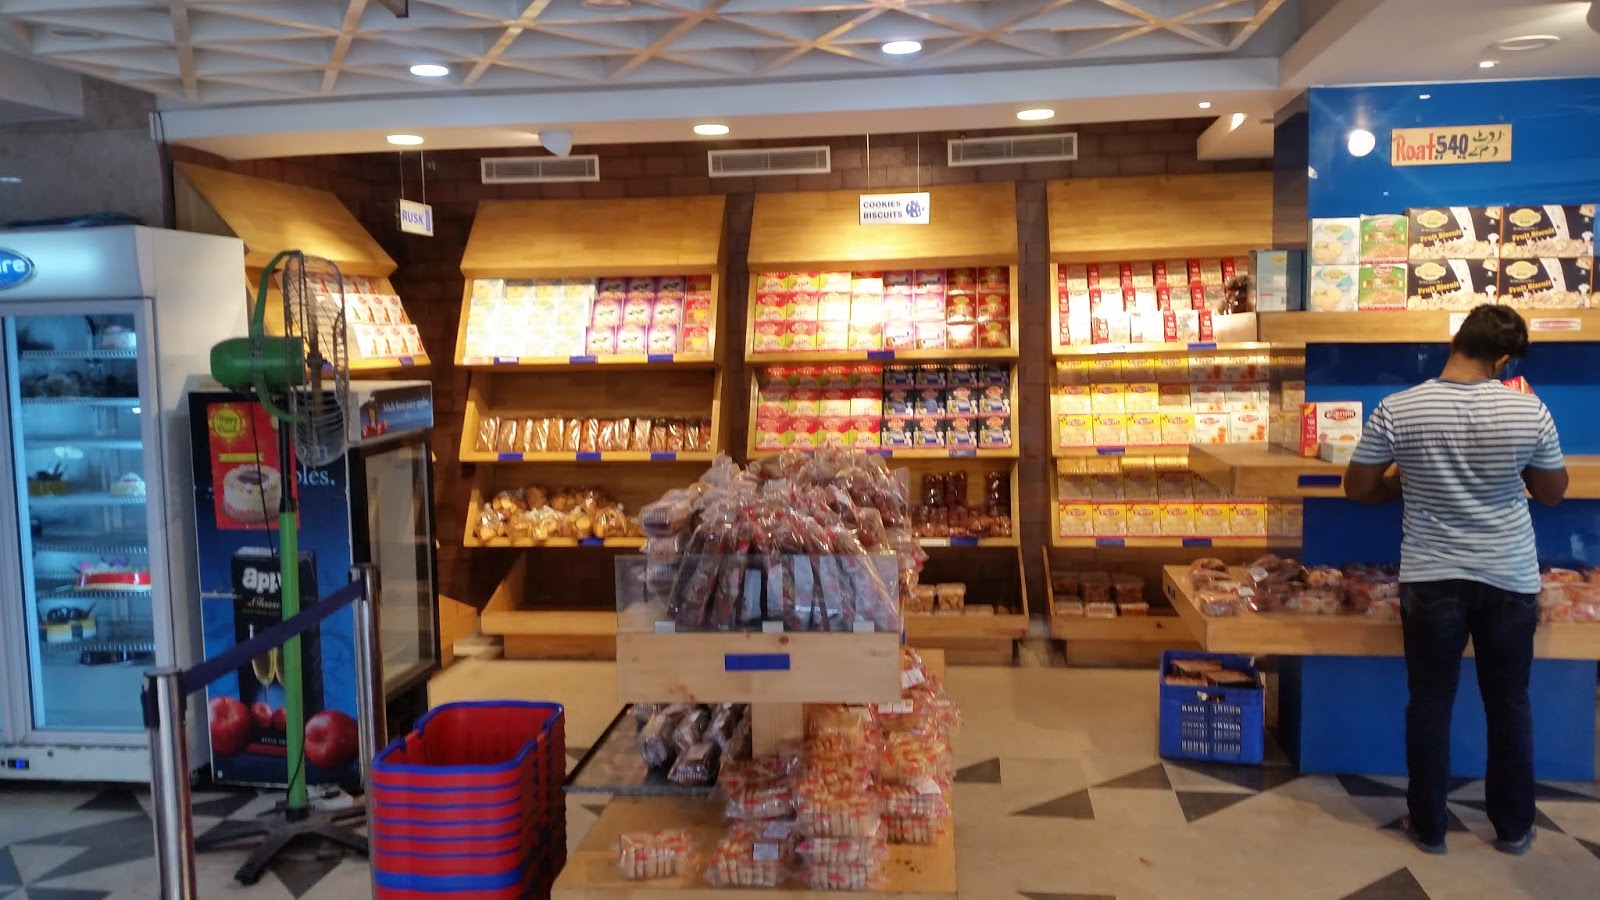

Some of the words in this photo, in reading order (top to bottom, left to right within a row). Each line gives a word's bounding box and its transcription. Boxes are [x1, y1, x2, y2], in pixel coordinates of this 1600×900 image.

[1394, 132, 1435, 161] Roat
[1435, 134, 1469, 155] 540
[863, 200, 901, 209] COOKIES
[402, 210, 425, 225] RUSK
[863, 210, 903, 219] BISCUITS
[1420, 233, 1439, 243] Fruit
[1438, 228, 1463, 241] Biscuit
[1511, 232, 1531, 242] Fruit
[1530, 227, 1556, 240] Biscuit
[1417, 285, 1436, 295] Fruit
[1435, 280, 1461, 293] Biscuit
[1508, 285, 1528, 295] Fruit
[1527, 279, 1553, 292] Biscuit
